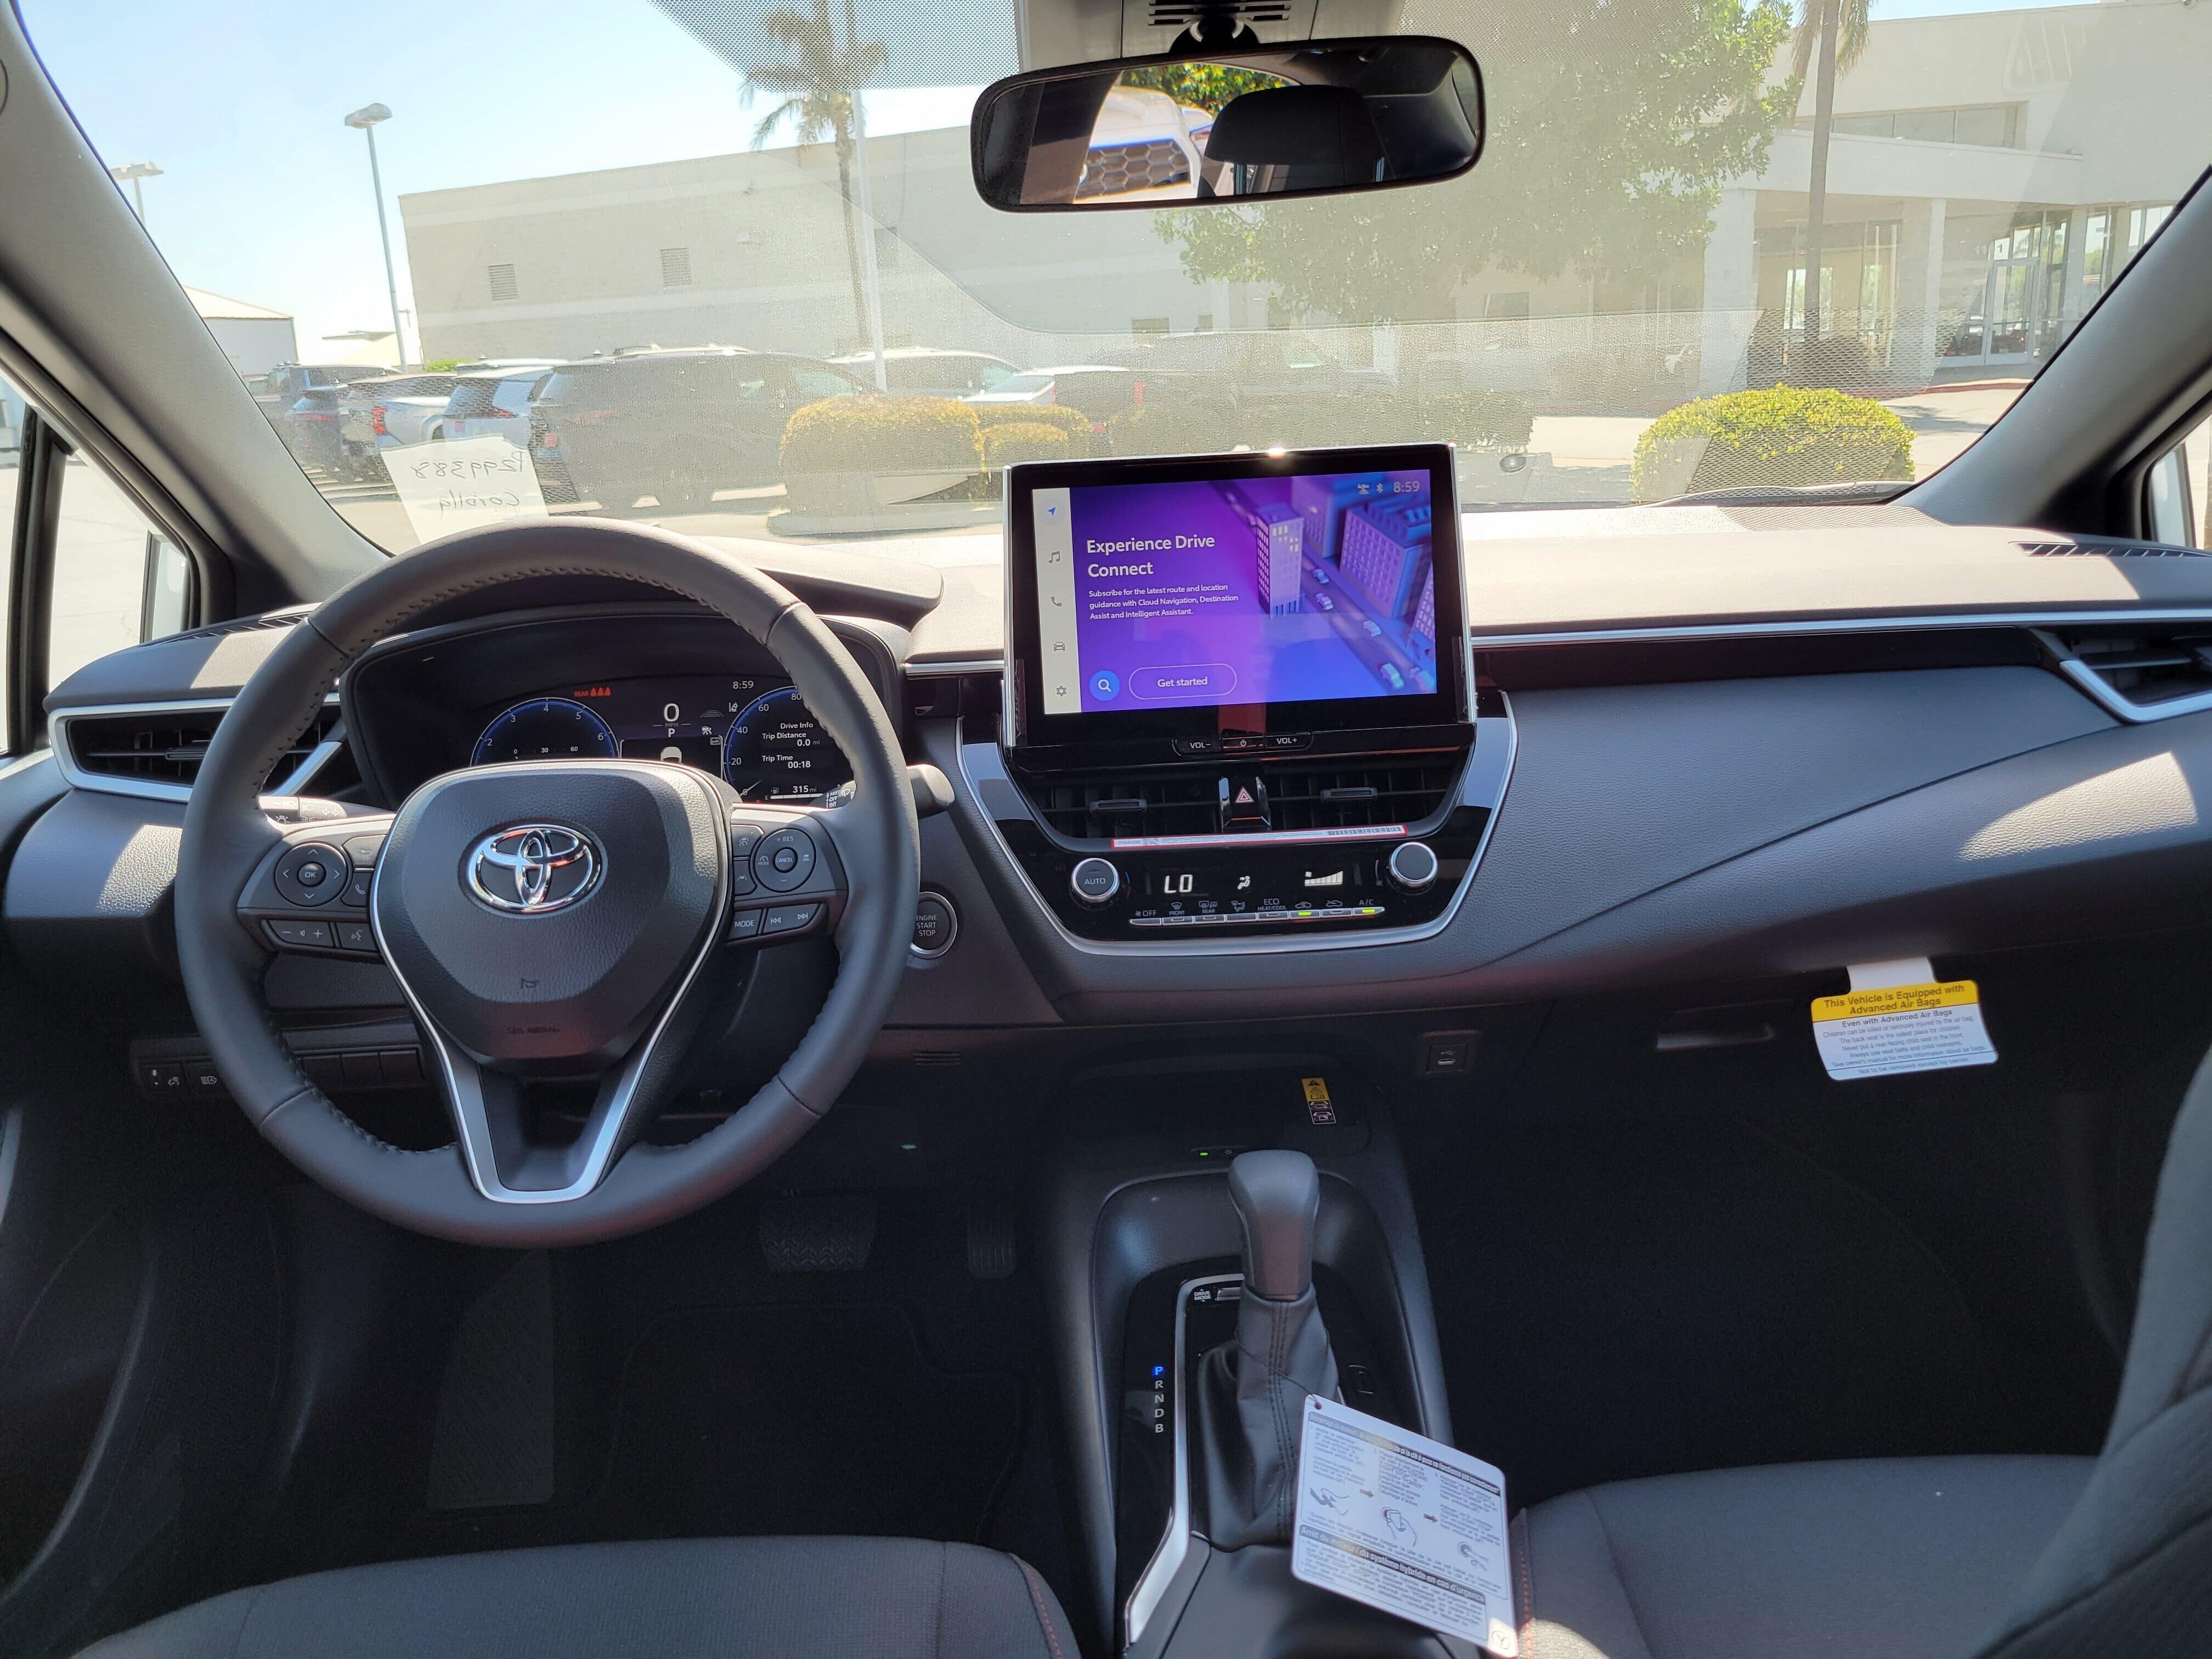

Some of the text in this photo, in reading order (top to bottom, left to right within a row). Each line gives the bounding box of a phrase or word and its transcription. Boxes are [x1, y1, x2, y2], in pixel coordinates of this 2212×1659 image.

[1393, 481, 1420, 493] 8:59
[1087, 534, 1215, 556] Experience Drive
[1088, 562, 1154, 577] Connect
[1088, 589, 1122, 597] Subscribe
[1089, 600, 1121, 610] guidance
[1160, 597, 1199, 606] Navigation,
[1199, 594, 1239, 603] Destination
[1090, 612, 1110, 620] Assist
[1126, 610, 1160, 619] Intelligent
[1161, 608, 1193, 616] Assistant.
[732, 681, 754, 690] 8:59
[1158, 676, 1208, 687] Get started
[663, 703, 680, 722] 0
[668, 728, 675, 738] P
[793, 785, 809, 793] 315
[1084, 877, 1106, 885] AUTO
[1164, 874, 1193, 894] LO
[735, 918, 755, 928] MODE
[1824, 998, 1845, 1008] This
[1847, 995, 1882, 1005] Vehicle
[1896, 988, 1942, 1001] Equipped
[1944, 985, 1964, 994] with
[1849, 997, 1941, 1015] Advanced Air Bags
[1881, 1013, 1918, 1023] Advanced
[1155, 1366, 1164, 1375] P
[1155, 1380, 1164, 1389] R
[1155, 1393, 1164, 1403] N
[1154, 1408, 1165, 1418] D
[1155, 1423, 1164, 1433] B
